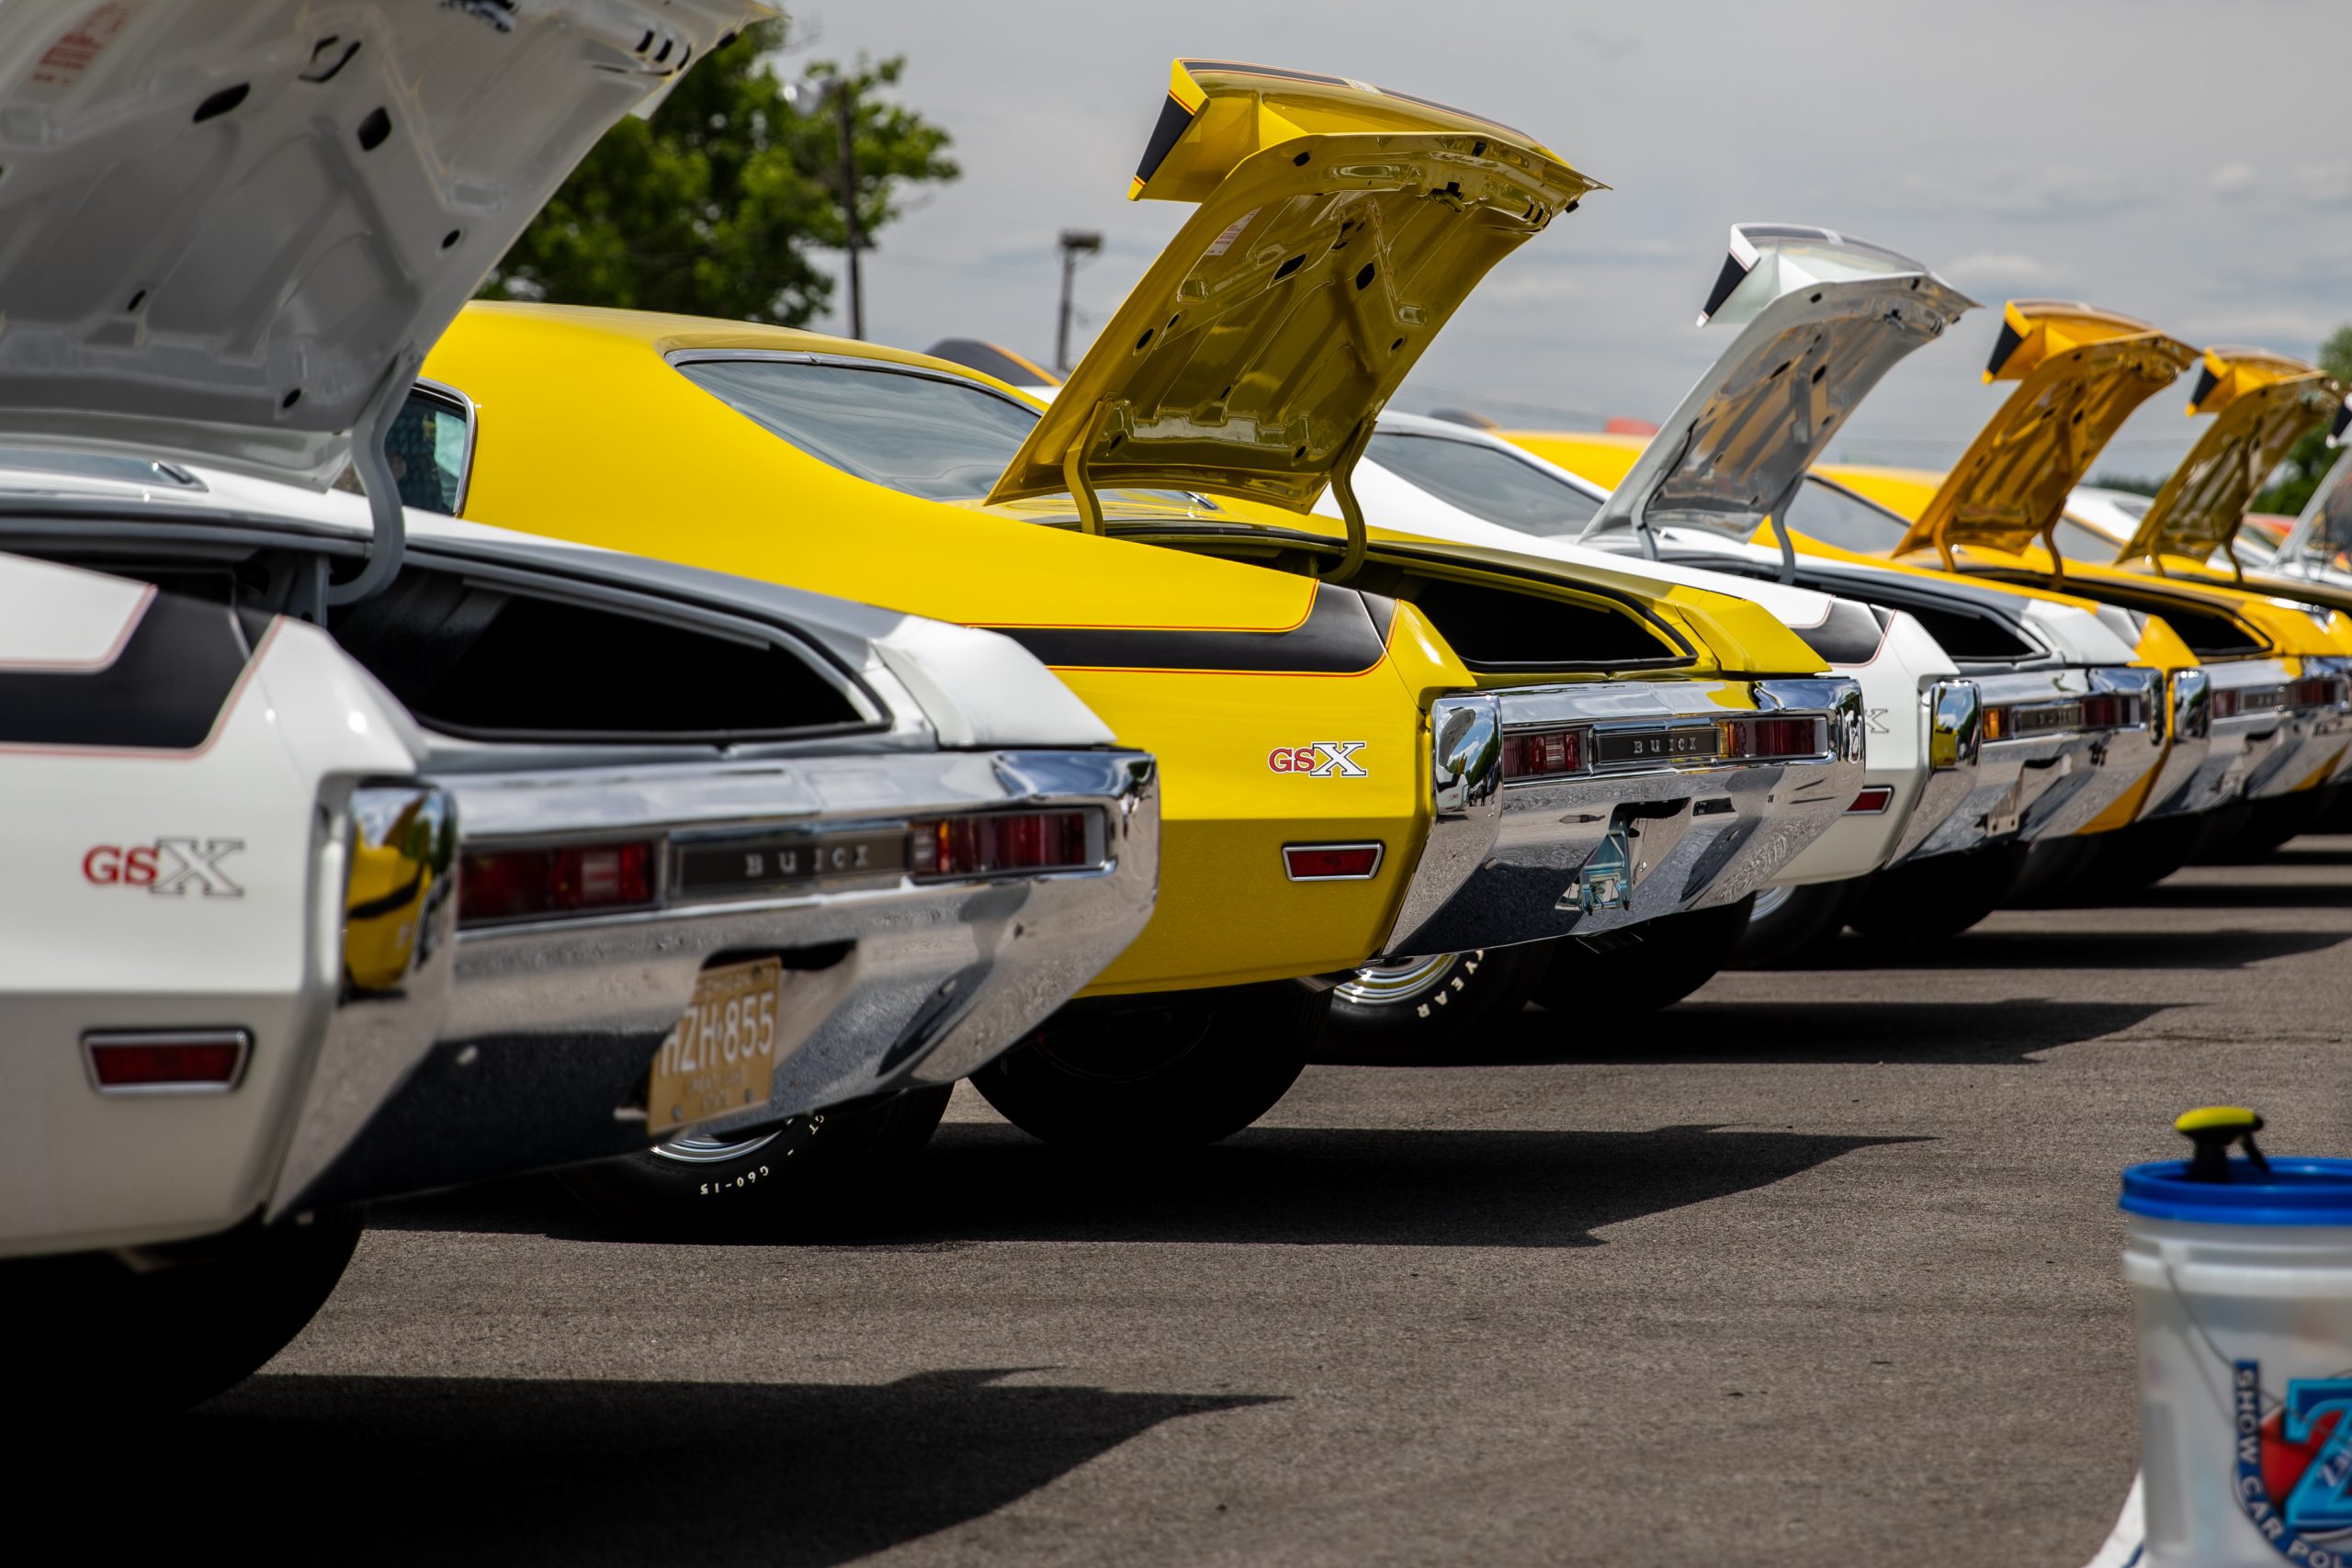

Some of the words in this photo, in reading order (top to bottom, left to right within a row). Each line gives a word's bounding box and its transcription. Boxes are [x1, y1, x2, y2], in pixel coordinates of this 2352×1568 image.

[1269, 741, 1368, 777] GSX
[1633, 737, 1697, 754] BUICK
[82, 837, 245, 897] GSX
[700, 1166, 769, 1195] G60-15
[2236, 1369, 2258, 1464] SHOW
[2243, 1475, 2285, 1540] CAR
